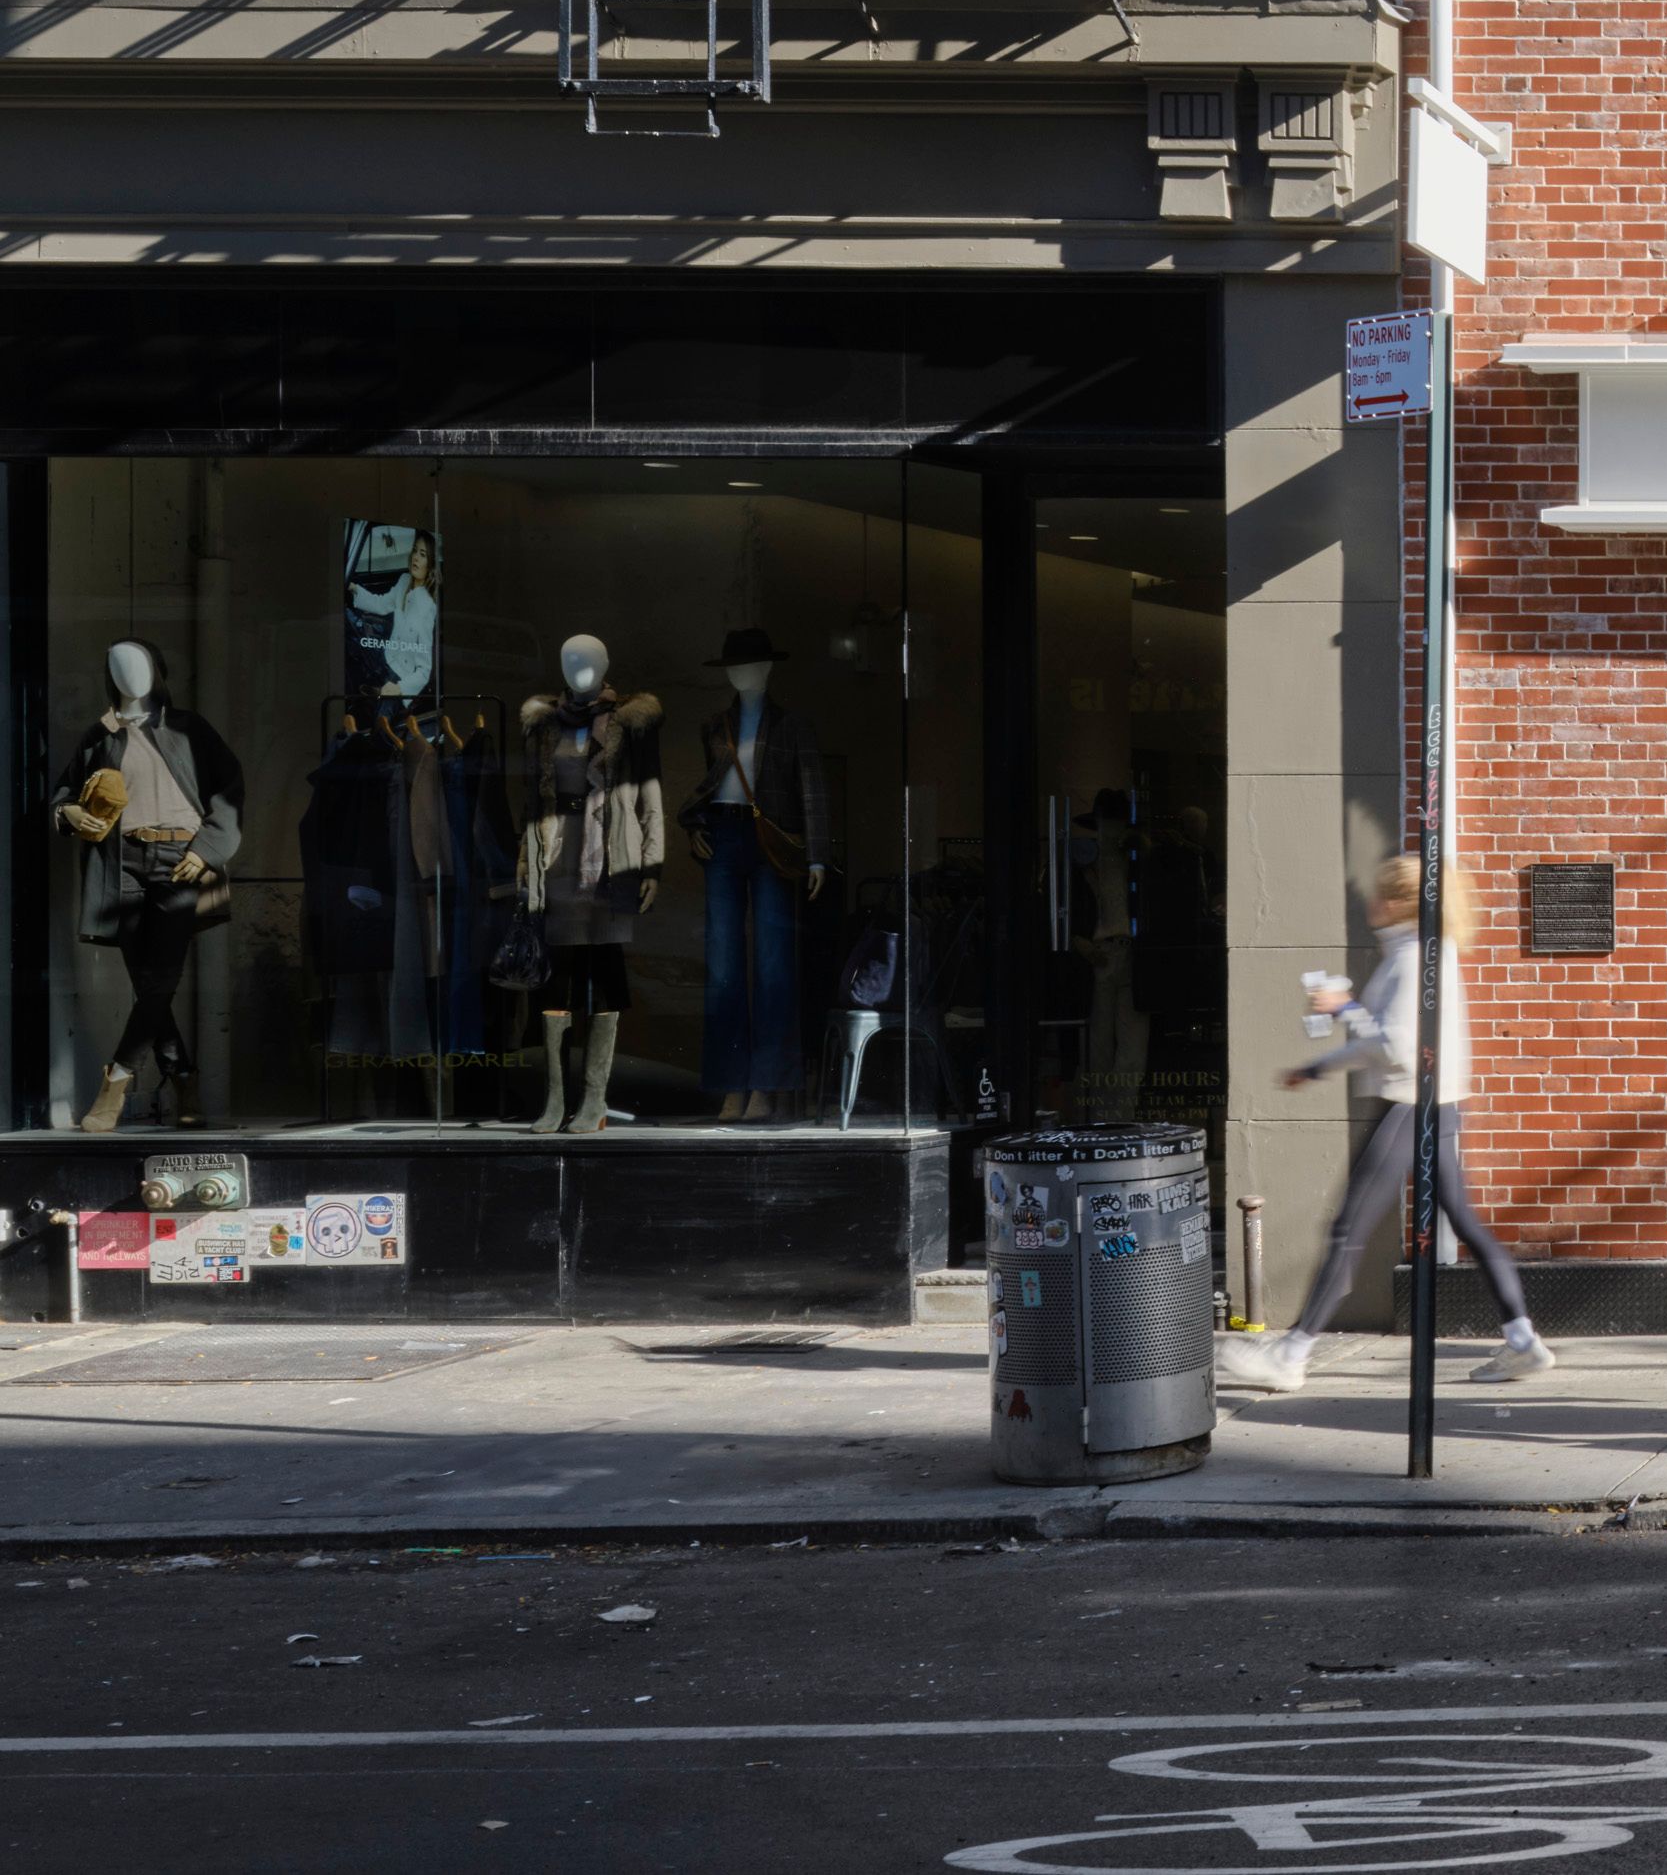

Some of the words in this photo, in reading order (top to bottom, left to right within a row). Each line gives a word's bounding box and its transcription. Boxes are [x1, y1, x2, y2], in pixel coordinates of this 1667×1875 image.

[1352, 329, 1366, 346] NO
[1368, 324, 1411, 344] PARKING
[1352, 352, 1381, 370] Monday
[1387, 348, 1411, 365] Friday
[1352, 371, 1369, 387] 8am
[1375, 369, 1392, 387] 6pm
[360, 637, 399, 651] GERARD
[325, 1052, 436, 1069] GERARD
[444, 1052, 533, 1069] DAREL
[1080, 1071, 1146, 1088] STORE
[1152, 1070, 1221, 1087] HOURS
[1094, 1146, 1137, 1160] Don't
[1143, 1140, 1175, 1157] litter
[162, 1156, 192, 1167] AUTO
[90, 1220, 139, 1229] SPRINKLER
[96, 1230, 145, 1240] BASEMENT
[82, 1252, 100, 1261] AND
